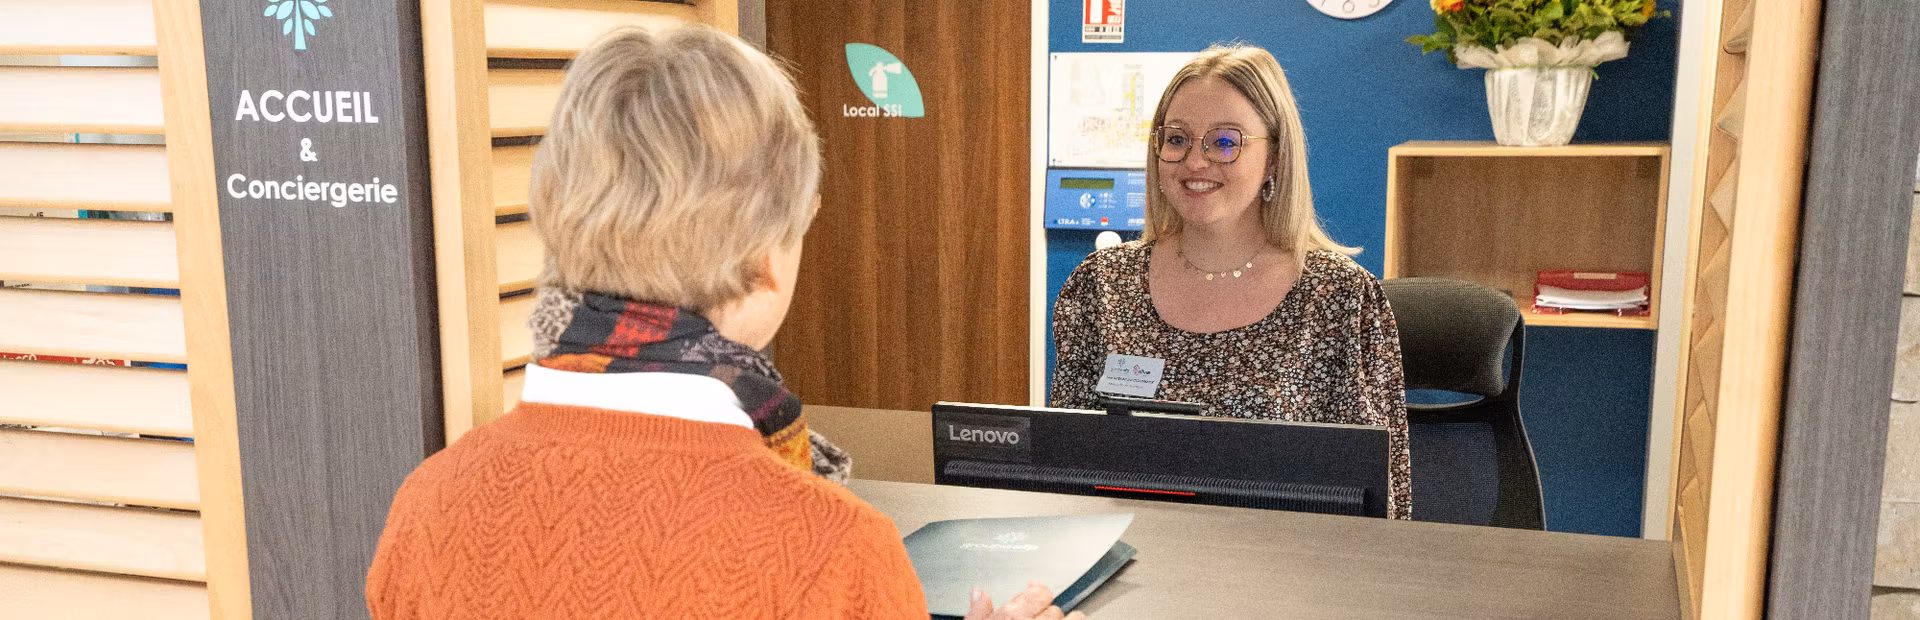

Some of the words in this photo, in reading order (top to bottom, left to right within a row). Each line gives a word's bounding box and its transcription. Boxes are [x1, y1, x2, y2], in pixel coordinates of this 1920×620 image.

[235, 90, 379, 123] ACCUEIL
[844, 104, 880, 117] Local
[300, 138, 317, 162] &
[227, 173, 398, 208] Conciergerie
[949, 425, 1020, 445] Lenovo
